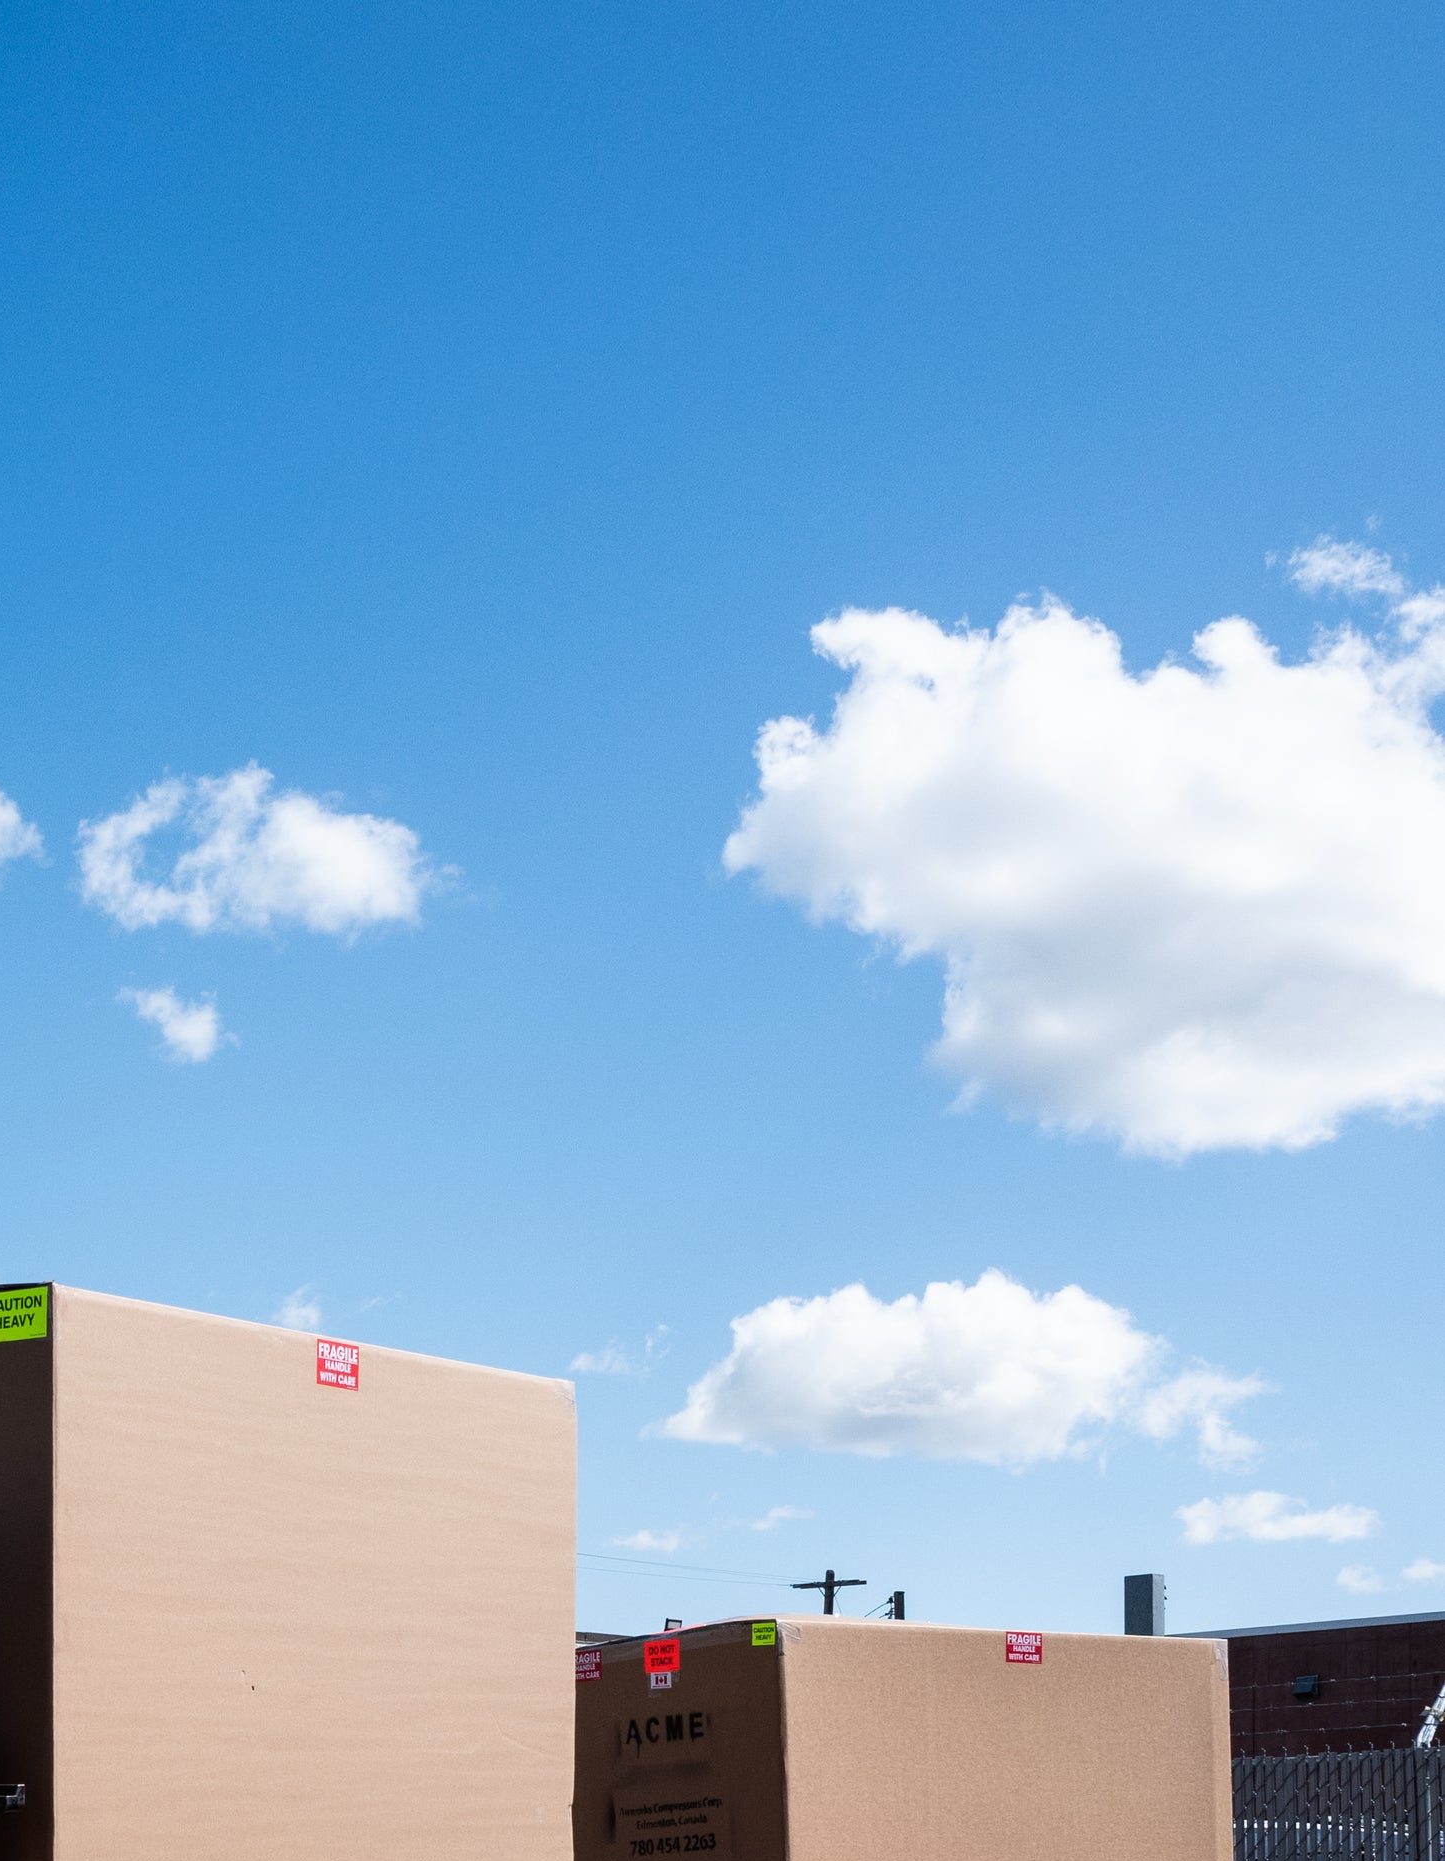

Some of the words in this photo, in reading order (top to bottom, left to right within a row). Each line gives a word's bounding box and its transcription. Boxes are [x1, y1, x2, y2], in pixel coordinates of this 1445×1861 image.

[318, 1342, 358, 1363] FRAGILE
[325, 1360, 351, 1373] HANDLE
[319, 1371, 337, 1383] WITH
[338, 1375, 356, 1387] CARE
[753, 1626, 774, 1634] CAUTION
[1007, 1633, 1042, 1646] FRAGILE
[648, 1646, 659, 1656] DO
[660, 1644, 674, 1654] NOT
[1012, 1645, 1036, 1653] HANDLE
[575, 1651, 601, 1664] RAGILE
[650, 1656, 674, 1667] STACK
[1008, 1653, 1024, 1661] WITH
[1024, 1654, 1040, 1662] CARE
[585, 1671, 601, 1679] CARE
[626, 1712, 705, 1745] ACME
[653, 1799, 702, 1813] Compressors
[678, 1813, 708, 1826] Canada
[630, 1839, 655, 1857] 780
[657, 1836, 681, 1854] 454
[683, 1832, 717, 1852] 2263
